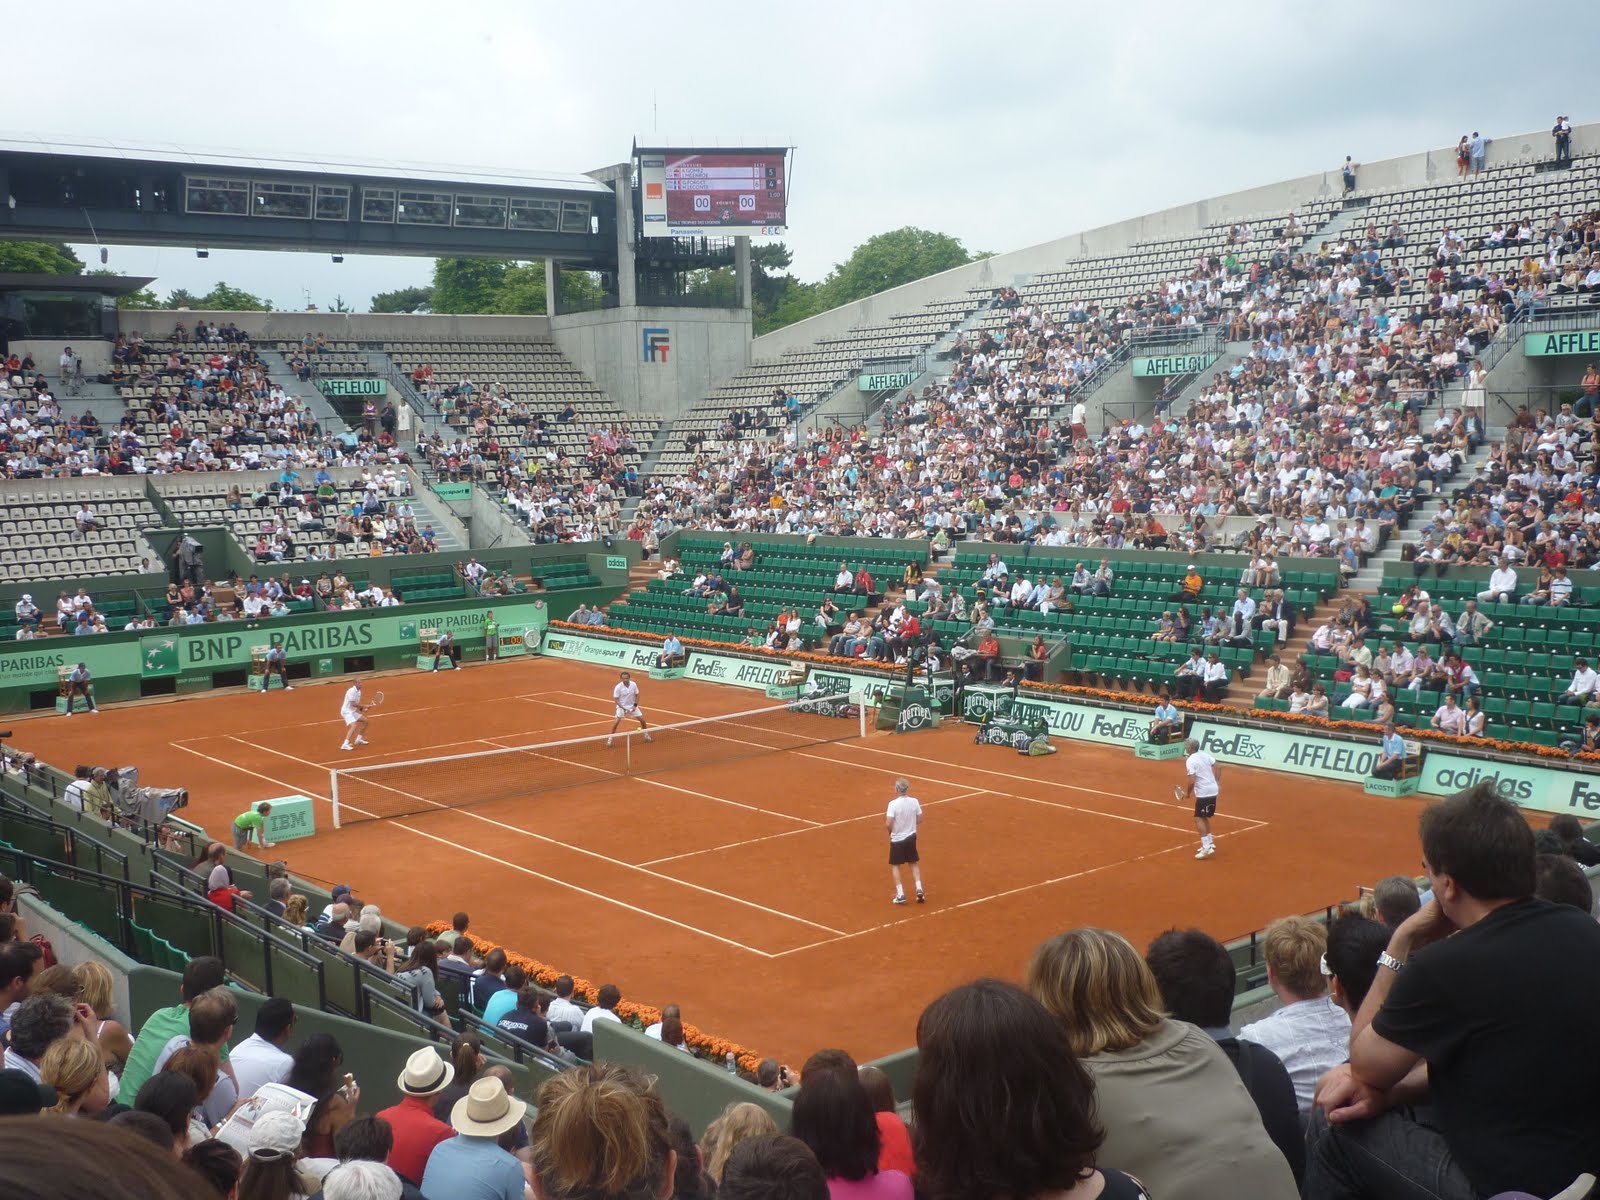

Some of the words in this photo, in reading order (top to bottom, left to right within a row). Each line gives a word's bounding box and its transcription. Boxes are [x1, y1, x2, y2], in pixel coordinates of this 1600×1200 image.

[696, 198, 709, 208] 00
[741, 198, 754, 208] 00
[1545, 332, 1600, 354] AFFLE
[1146, 356, 1207, 375] AFFLELOU
[322, 380, 380, 394] AFFLELOU
[869, 373, 912, 389] AFFLELOU
[608, 559, 625, 567] adidas
[420, 617, 443, 629] BNP
[446, 613, 487, 627] PARIBA
[188, 636, 242, 662] BNP
[269, 623, 373, 652] PARIBAS
[584, 645, 602, 656] Orange
[1, 654, 65, 672] PARIBAS
[631, 649, 657, 667] FedE
[692, 658, 727, 678] FedEx
[899, 707, 931, 730] perrier
[1090, 714, 1149, 741] FedEx
[1199, 729, 1266, 760] FedEx
[1365, 783, 1395, 793] LACOSTE
[1568, 780, 1600, 811] Fe
[271, 811, 307, 832] IBM
